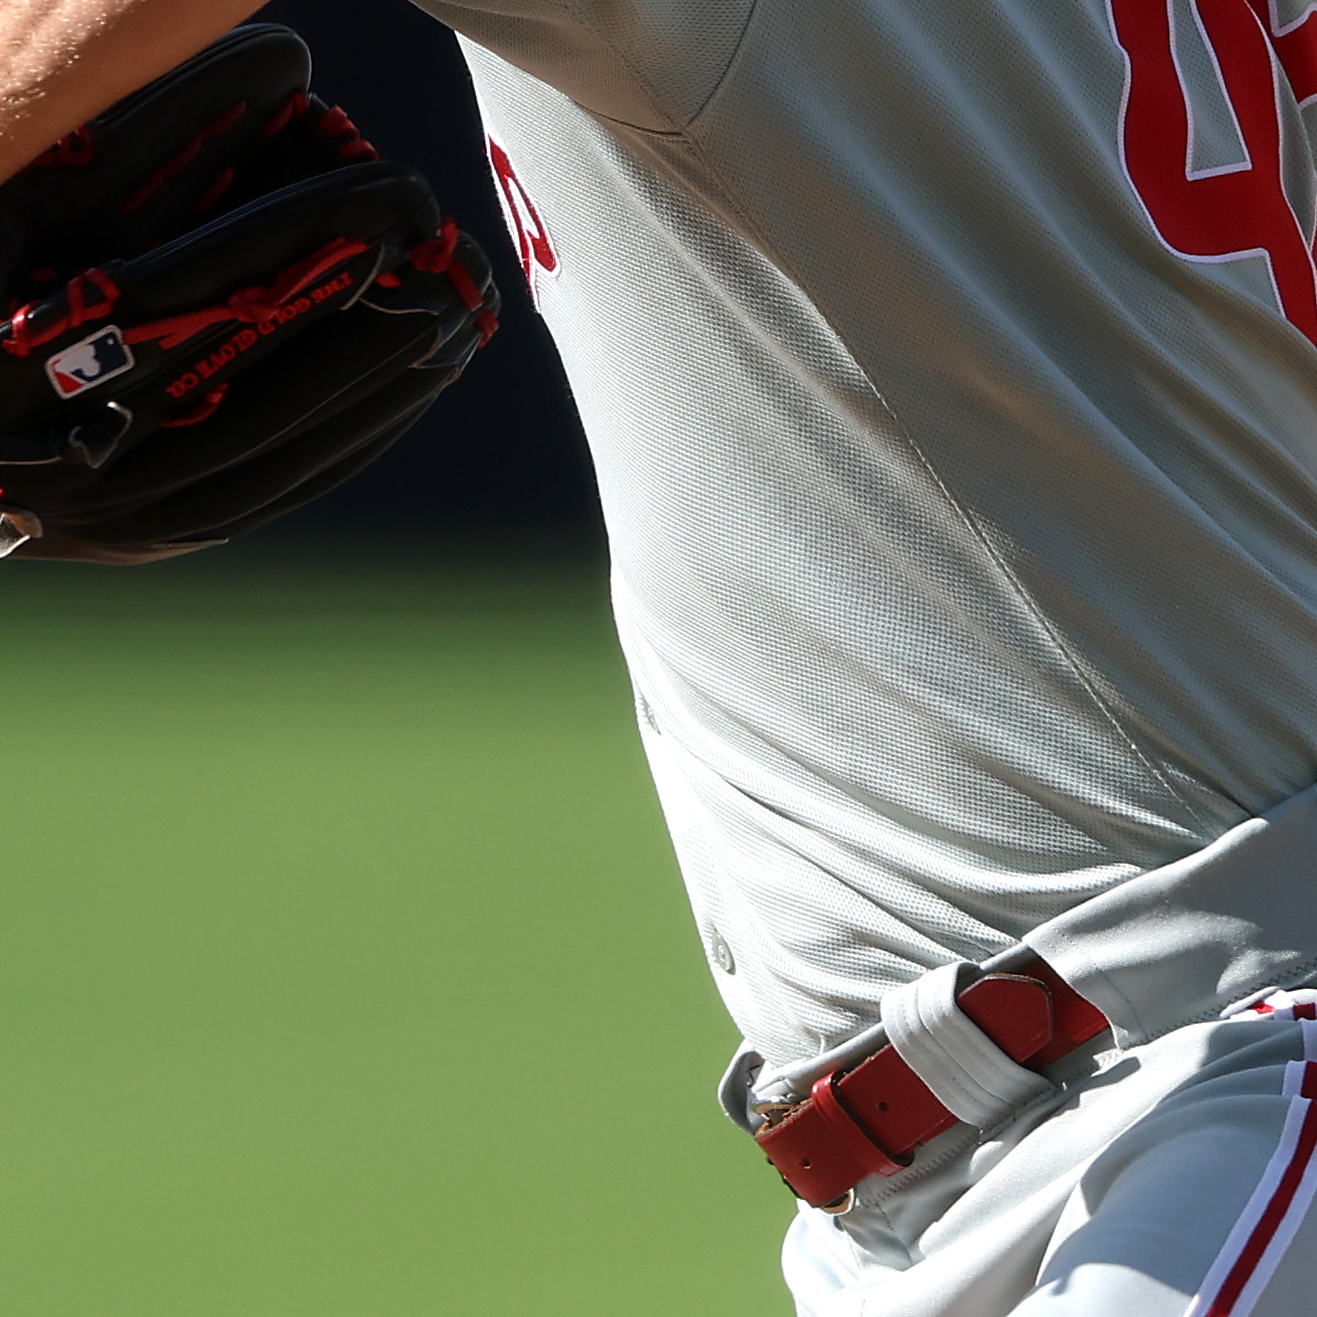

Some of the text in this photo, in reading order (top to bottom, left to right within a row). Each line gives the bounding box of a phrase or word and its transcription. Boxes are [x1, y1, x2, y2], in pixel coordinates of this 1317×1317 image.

[311, 272, 355, 303] THE
[257, 297, 311, 335] GOLD
[195, 329, 258, 378] GLOVE
